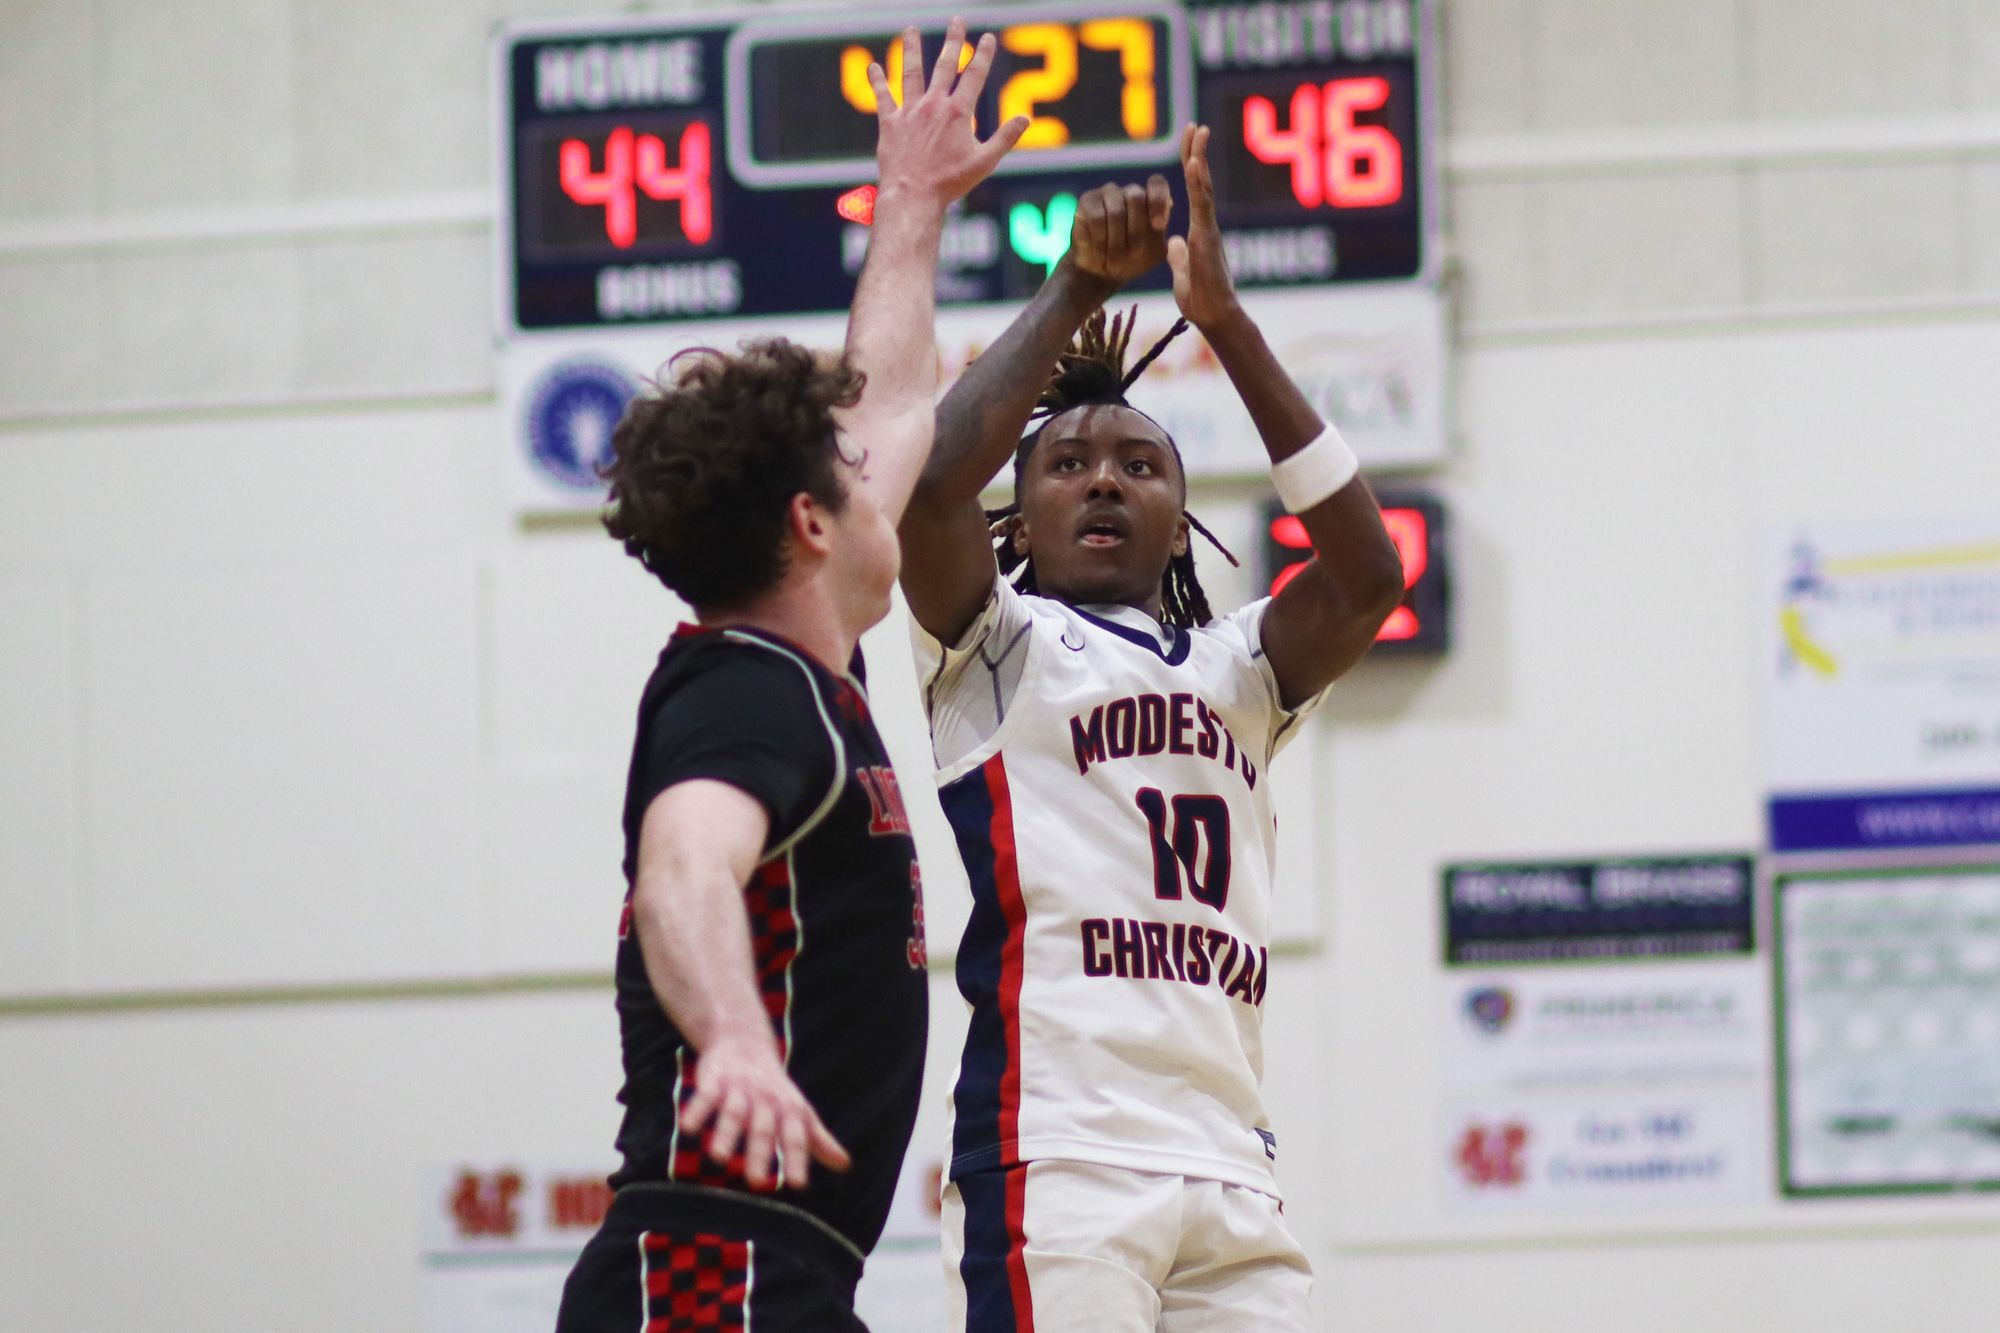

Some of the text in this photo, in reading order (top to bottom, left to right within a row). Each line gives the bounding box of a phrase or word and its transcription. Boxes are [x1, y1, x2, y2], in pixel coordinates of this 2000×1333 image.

[1200, 1, 1412, 66] VISITOR
[535, 39, 702, 110] HOME
[1242, 76, 1402, 209] 46
[559, 122, 712, 248] 44
[598, 263, 739, 317] BONUS
[1222, 228, 1335, 279] ONUS
[1135, 786, 1231, 913] 10
[1081, 918, 1267, 1008] CHRISTIAN
